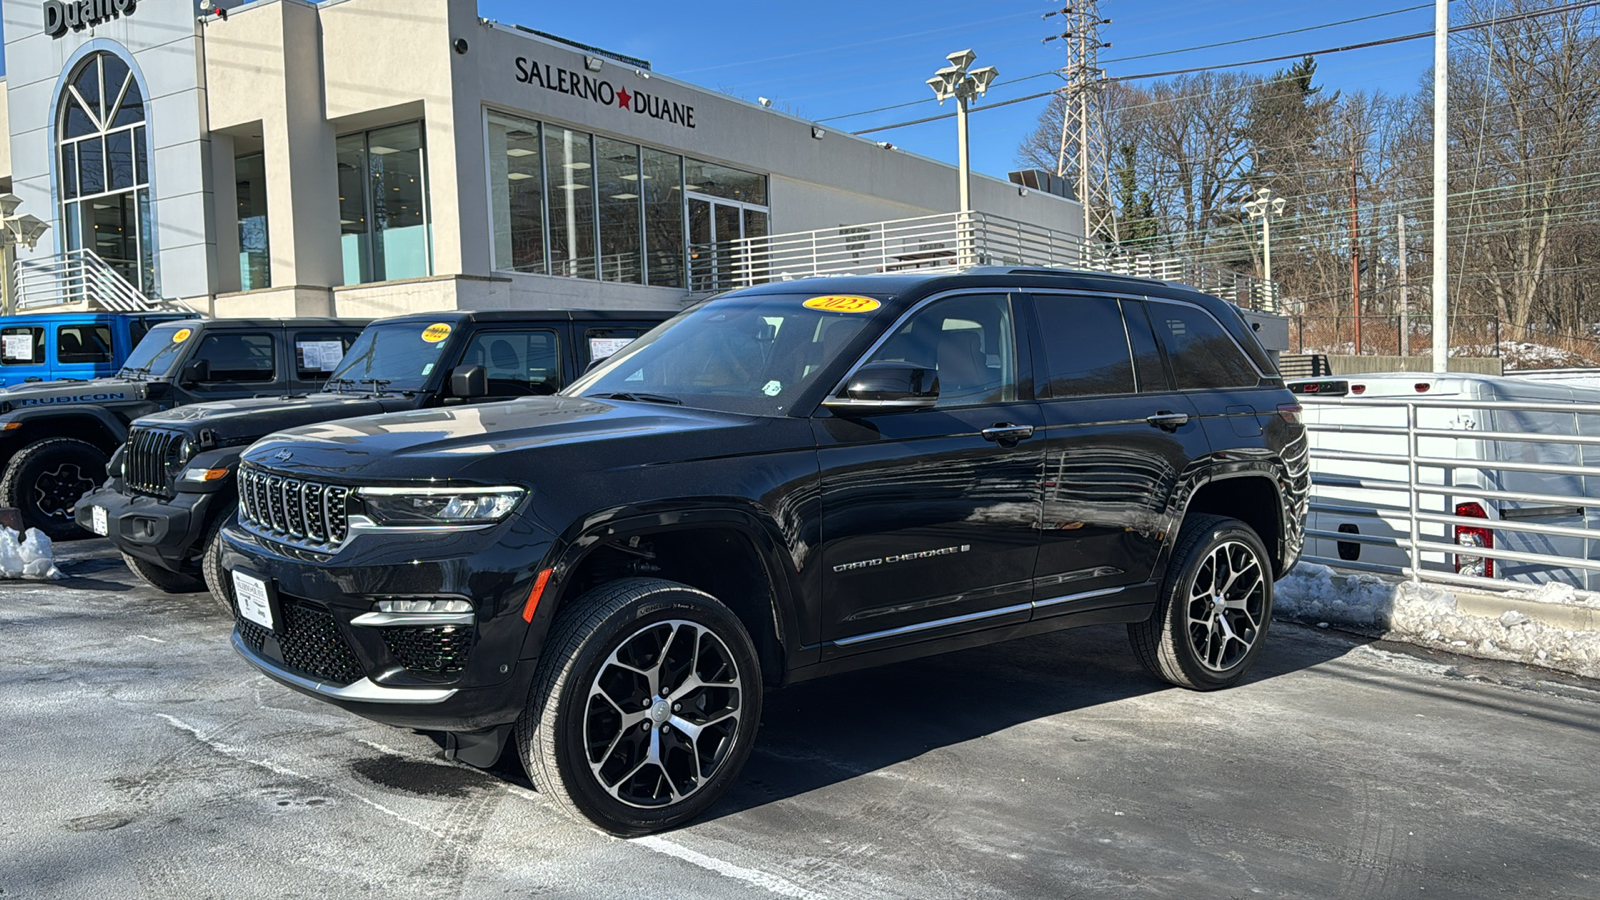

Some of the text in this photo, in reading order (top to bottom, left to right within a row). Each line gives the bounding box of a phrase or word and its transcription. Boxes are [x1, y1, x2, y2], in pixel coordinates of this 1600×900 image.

[514, 56, 696, 129] SALERNO DUANE
[812, 297, 870, 310] 2023
[21, 392, 125, 407] RUBICON
[832, 546, 958, 573] GRAND CHEROKEE
